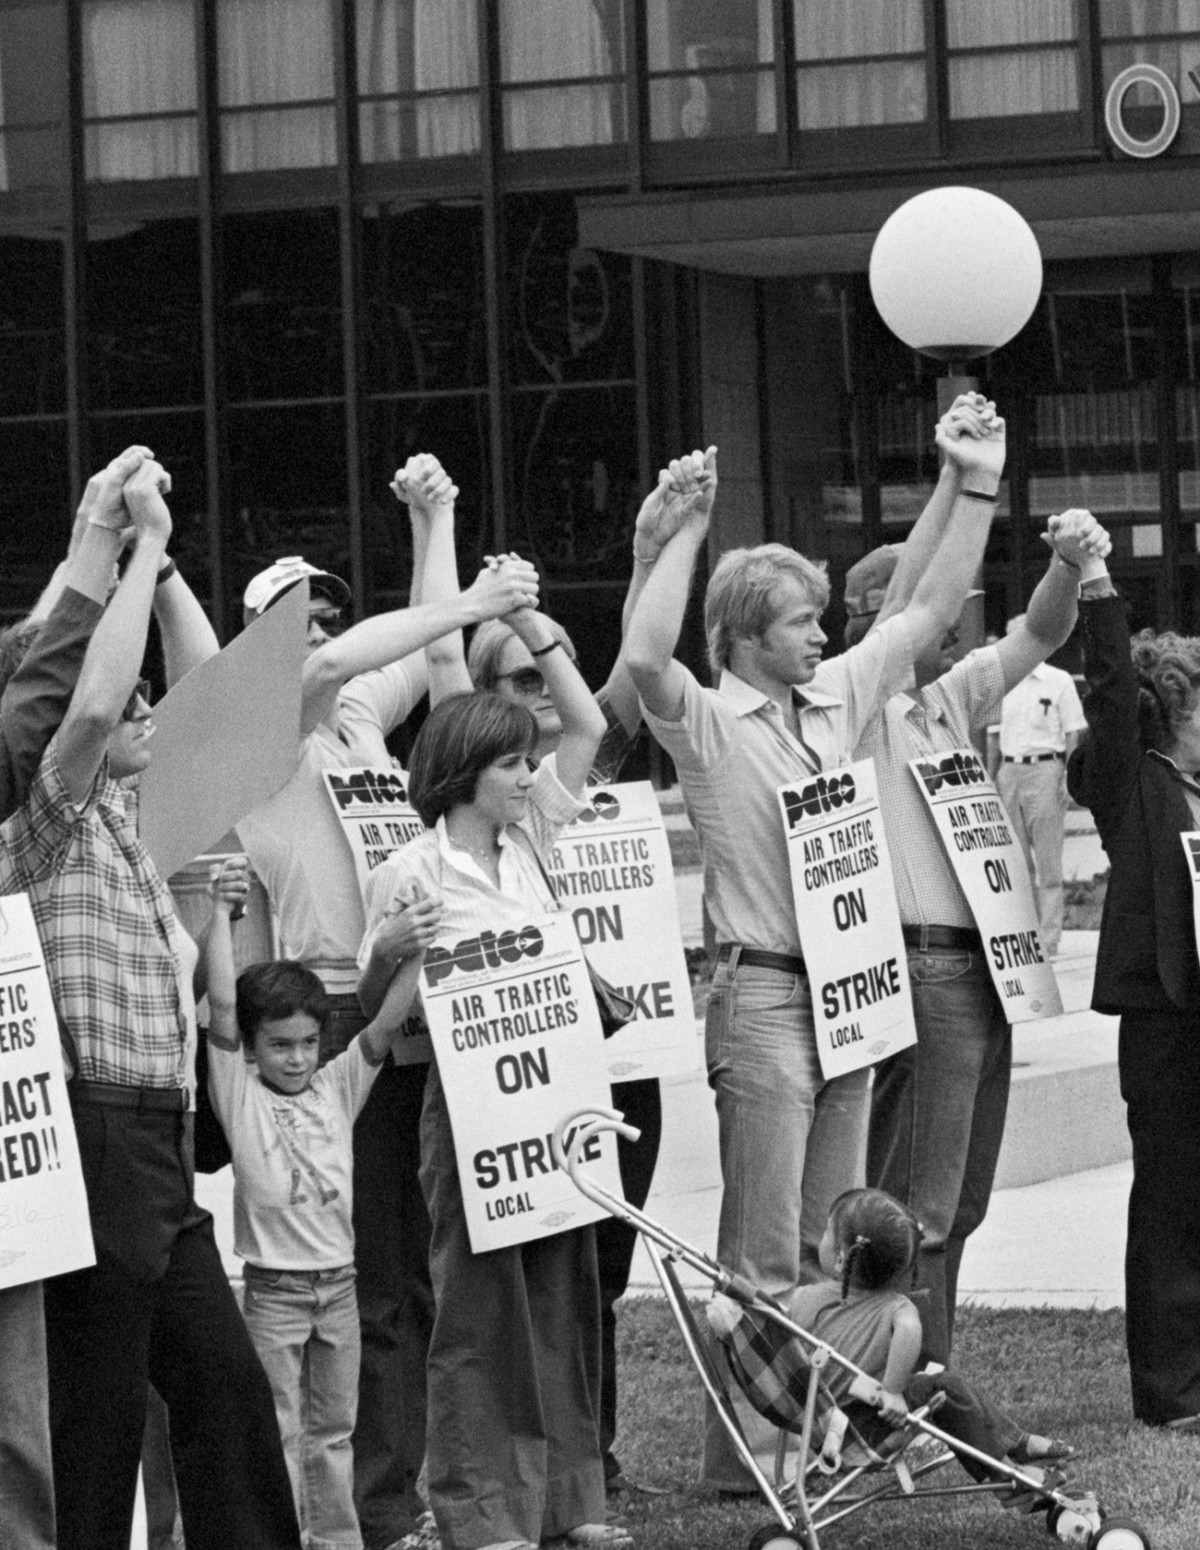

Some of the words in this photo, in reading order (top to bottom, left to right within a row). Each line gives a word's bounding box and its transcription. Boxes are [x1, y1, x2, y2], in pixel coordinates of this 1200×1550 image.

[359, 823, 384, 846] AIR
[384, 822, 428, 846] TRAFF
[948, 805, 970, 828] AIR
[971, 801, 1004, 824] TRAFFIC
[548, 848, 565, 870] IR
[573, 838, 650, 868] TRAFFIC
[803, 837, 823, 865] AIR
[829, 819, 874, 855] TRAFFIC
[549, 864, 655, 897] ONTROLLERS'
[804, 843, 879, 891] CONTROLLERS'
[983, 859, 1012, 893] ON
[571, 904, 624, 945] ON
[833, 887, 868, 932] ON
[423, 925, 543, 988] patco
[989, 930, 1044, 971] STRIKE
[451, 994, 486, 1024] AIR
[494, 972, 572, 1012] TRAFFIC
[821, 957, 901, 1020] STRIKE
[1002, 978, 1025, 998] LOCAL
[401, 1016, 430, 1036] LOC
[452, 999, 579, 1052] CONTROLLERS'
[830, 1022, 864, 1049] LOCAL
[495, 1046, 551, 1095] ON
[485, 1192, 535, 1221] LOCAL
